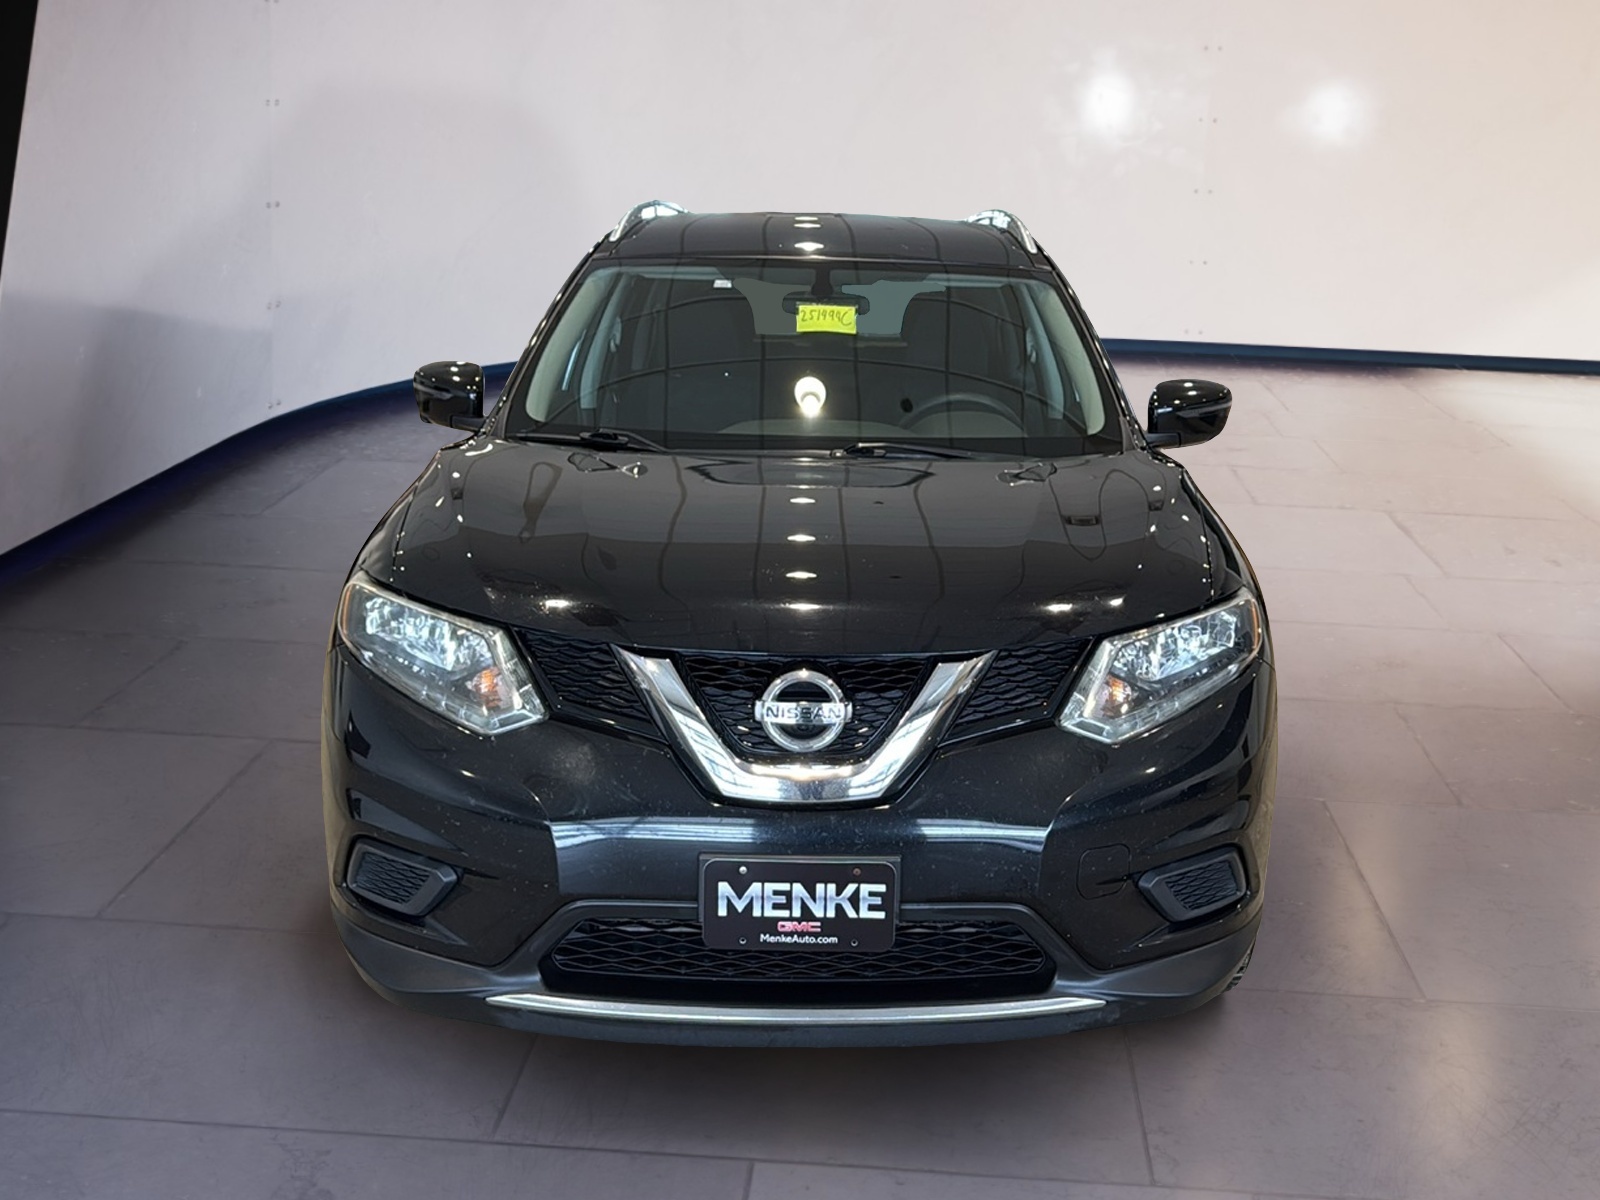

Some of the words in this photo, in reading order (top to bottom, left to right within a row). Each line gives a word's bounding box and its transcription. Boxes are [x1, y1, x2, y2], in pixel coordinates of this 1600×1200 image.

[765, 705, 842, 719] NISSAN
[717, 881, 887, 919] MENKE
[777, 921, 821, 932] GMC
[760, 933, 838, 944] MenkeAuto.com
